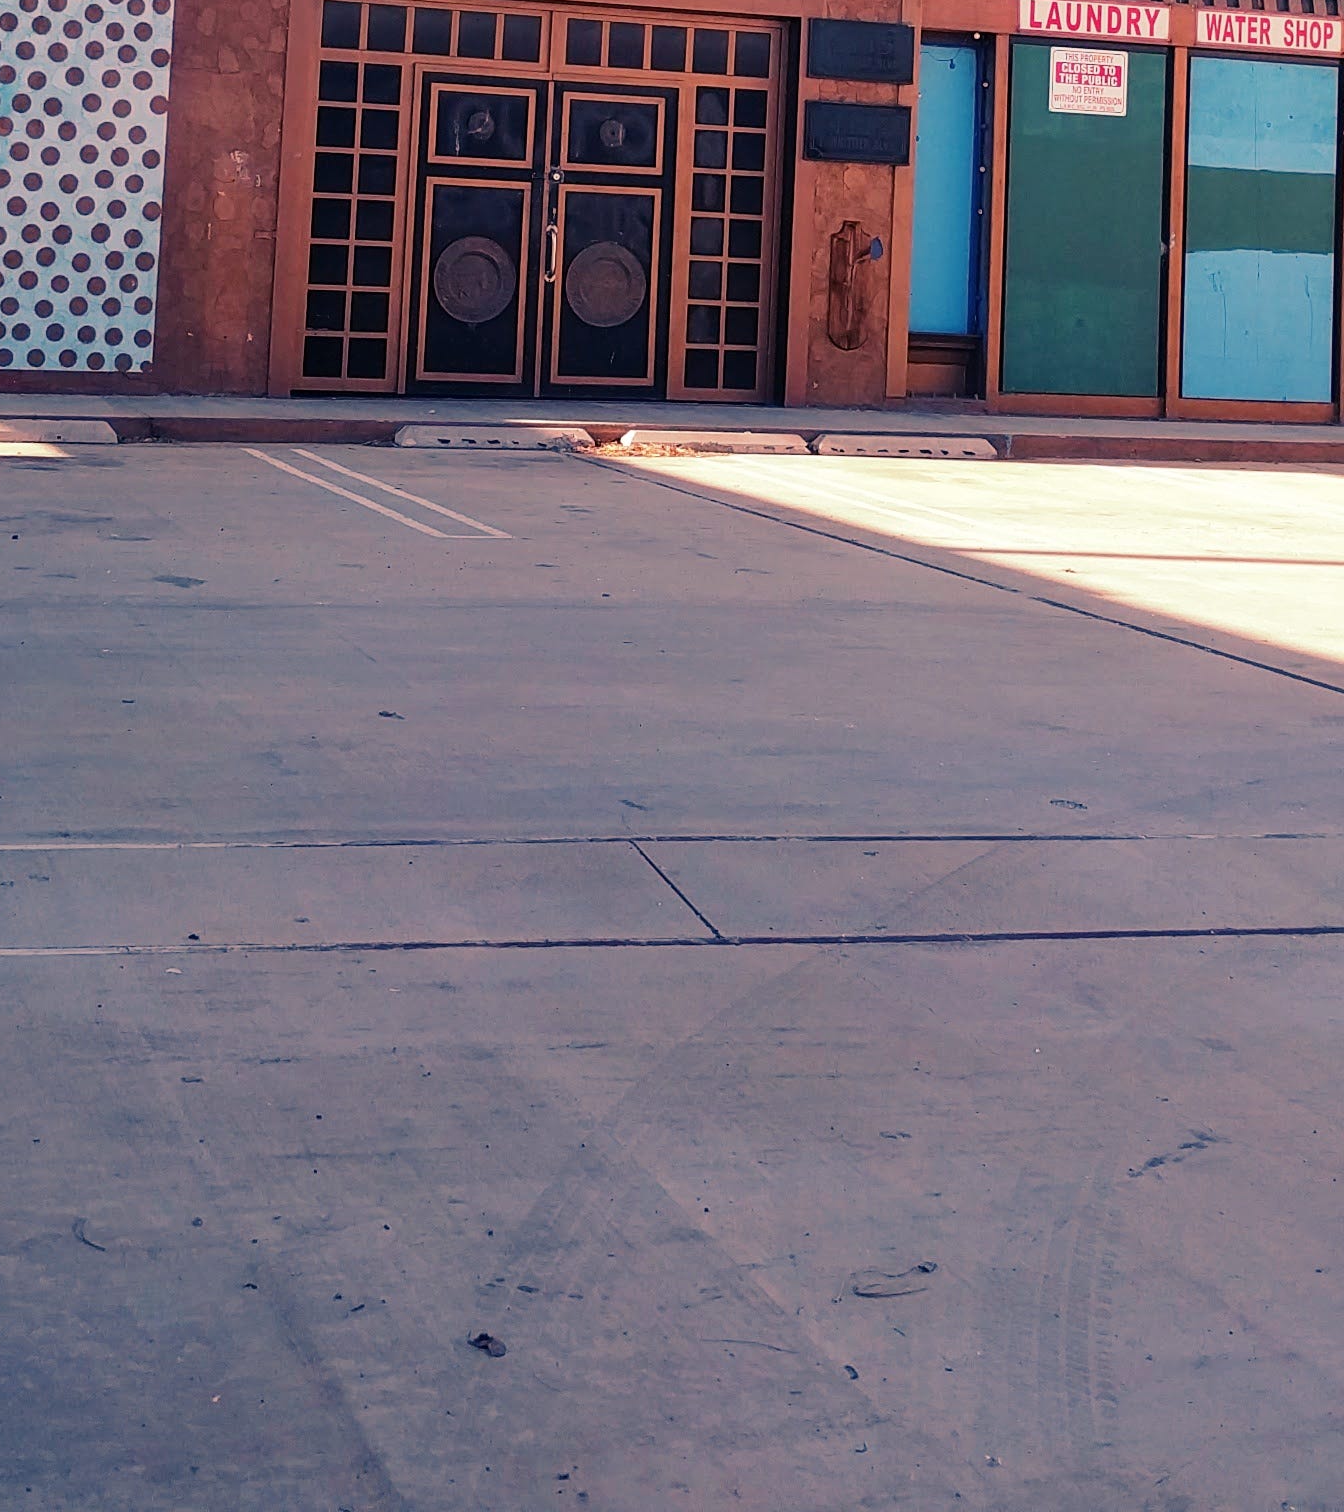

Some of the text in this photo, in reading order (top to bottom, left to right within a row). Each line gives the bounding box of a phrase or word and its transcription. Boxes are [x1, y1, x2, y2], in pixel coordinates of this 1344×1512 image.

[1029, 0, 1161, 37] LAUNDRY
[1205, 13, 1334, 49] WATER SHOP
[1065, 52, 1114, 64] THIS PROPERTY
[1061, 62, 1116, 76] CLOSED TO
[1059, 73, 1118, 86] THE PUBLIC
[1072, 85, 1105, 95] NO ENTRY
